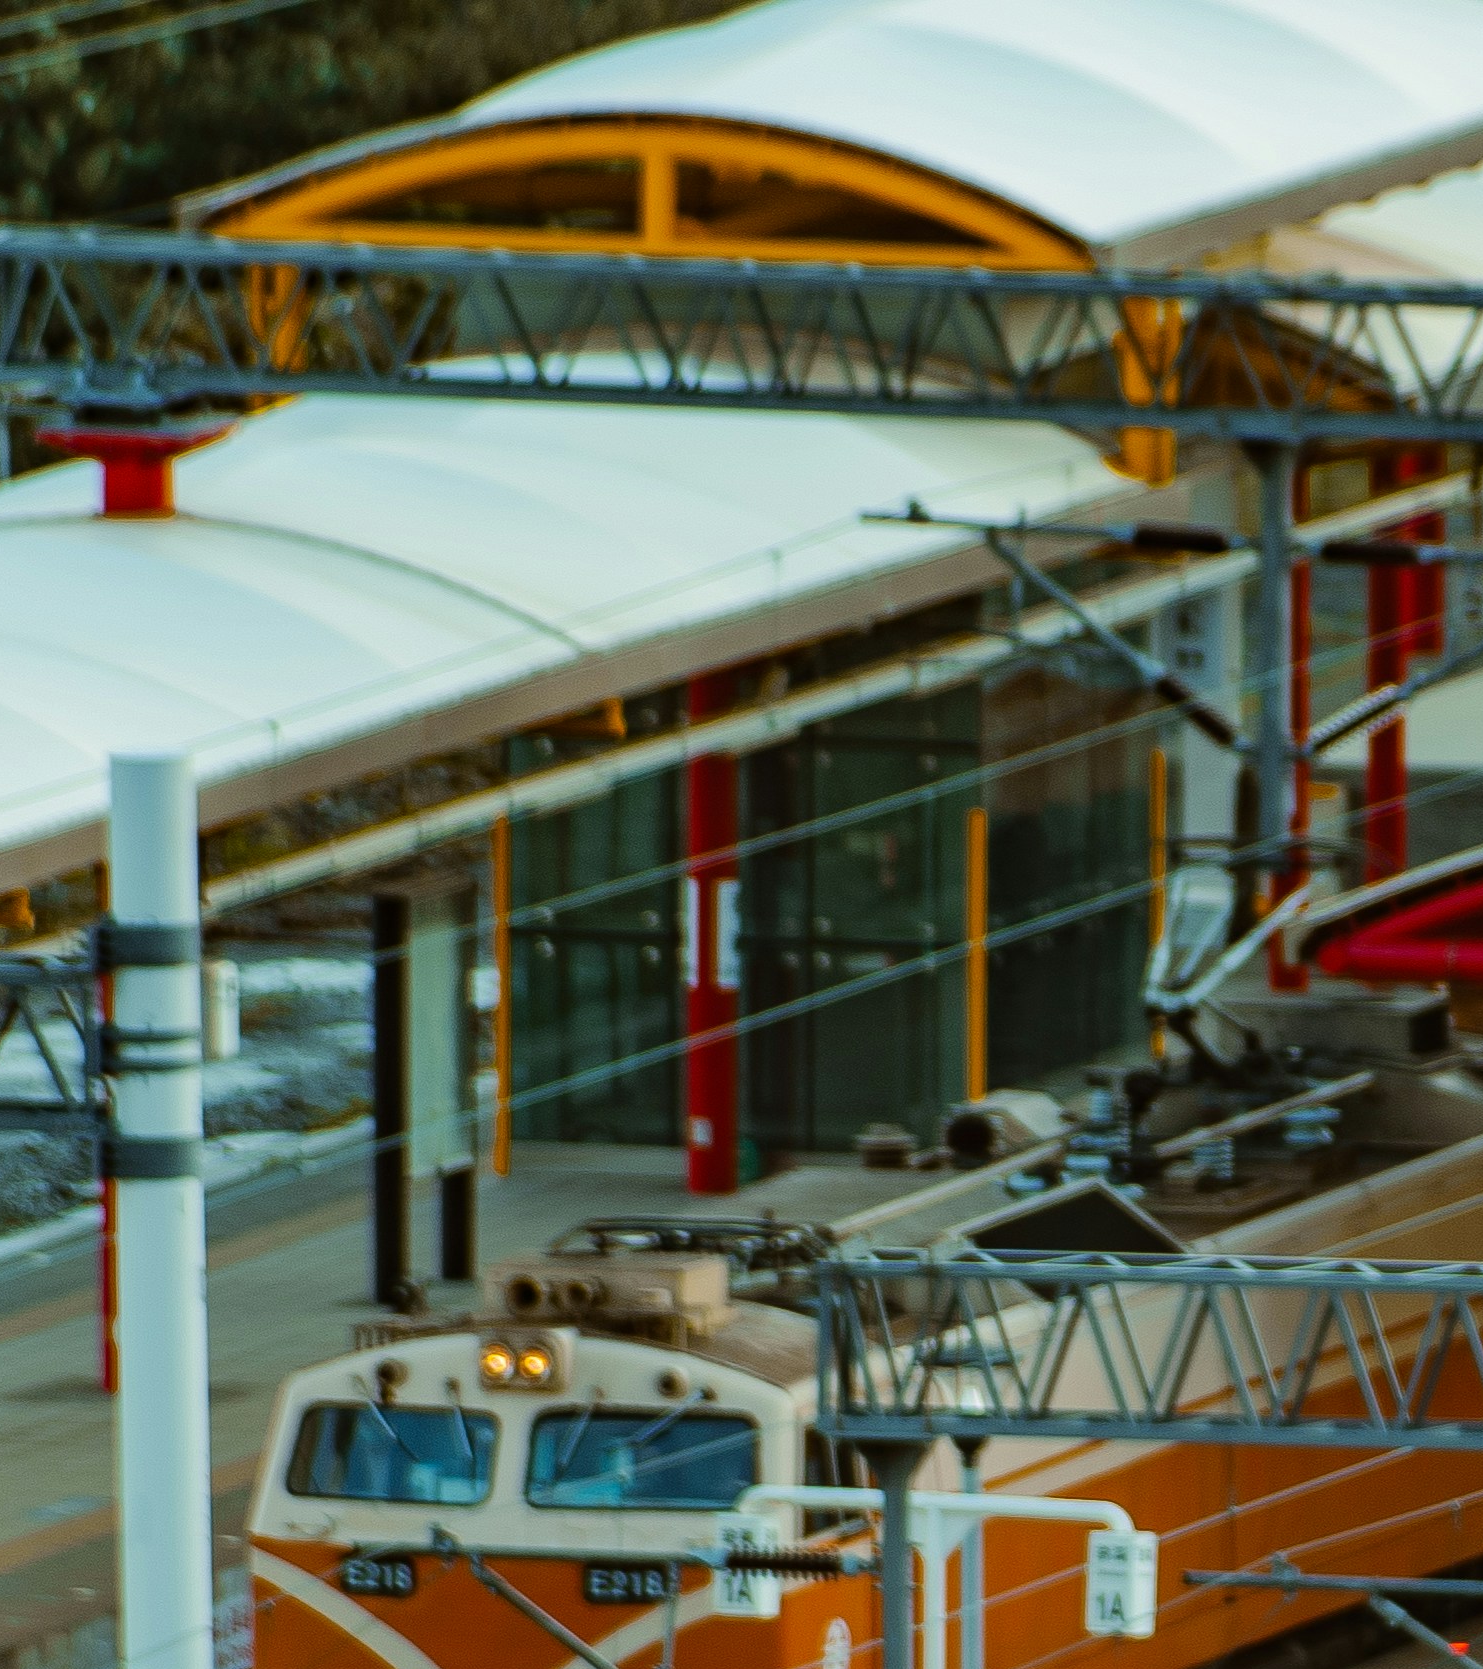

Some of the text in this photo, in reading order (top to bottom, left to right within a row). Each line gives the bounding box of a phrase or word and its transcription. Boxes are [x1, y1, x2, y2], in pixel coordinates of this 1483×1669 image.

[342, 1559, 413, 1590] E218
[591, 1569, 664, 1596] E218
[1096, 1592, 1126, 1621] 1A
